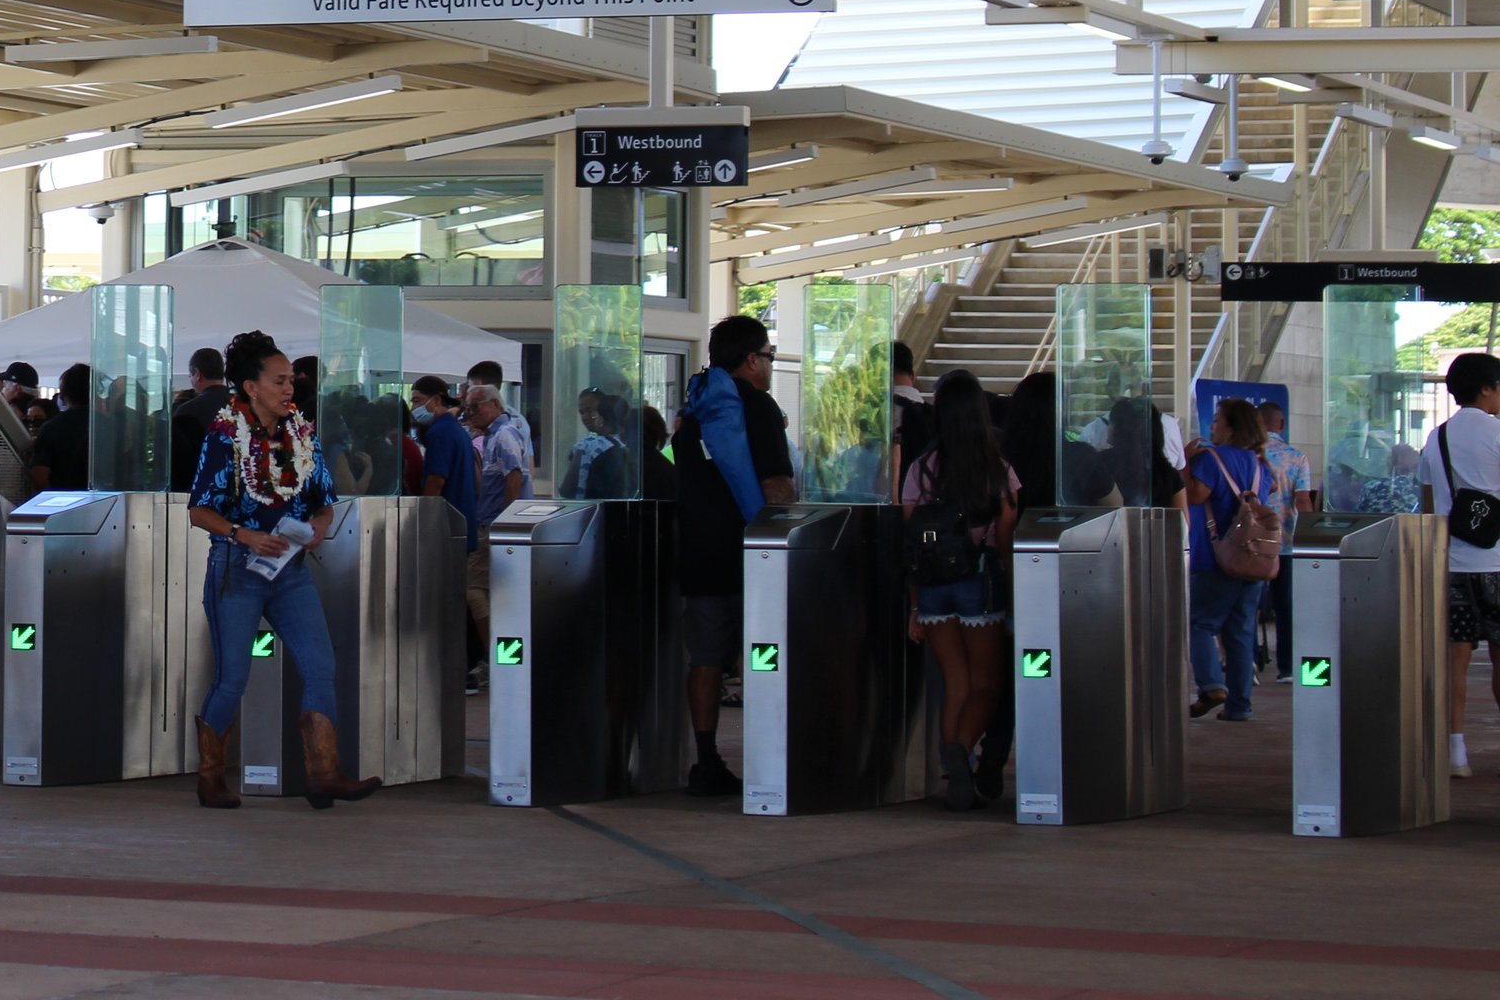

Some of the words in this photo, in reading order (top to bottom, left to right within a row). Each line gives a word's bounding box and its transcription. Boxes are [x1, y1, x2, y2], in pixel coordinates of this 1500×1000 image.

[590, 138, 599, 153] 1
[618, 134, 703, 150] Westbound
[1357, 267, 1418, 278] Westbound
